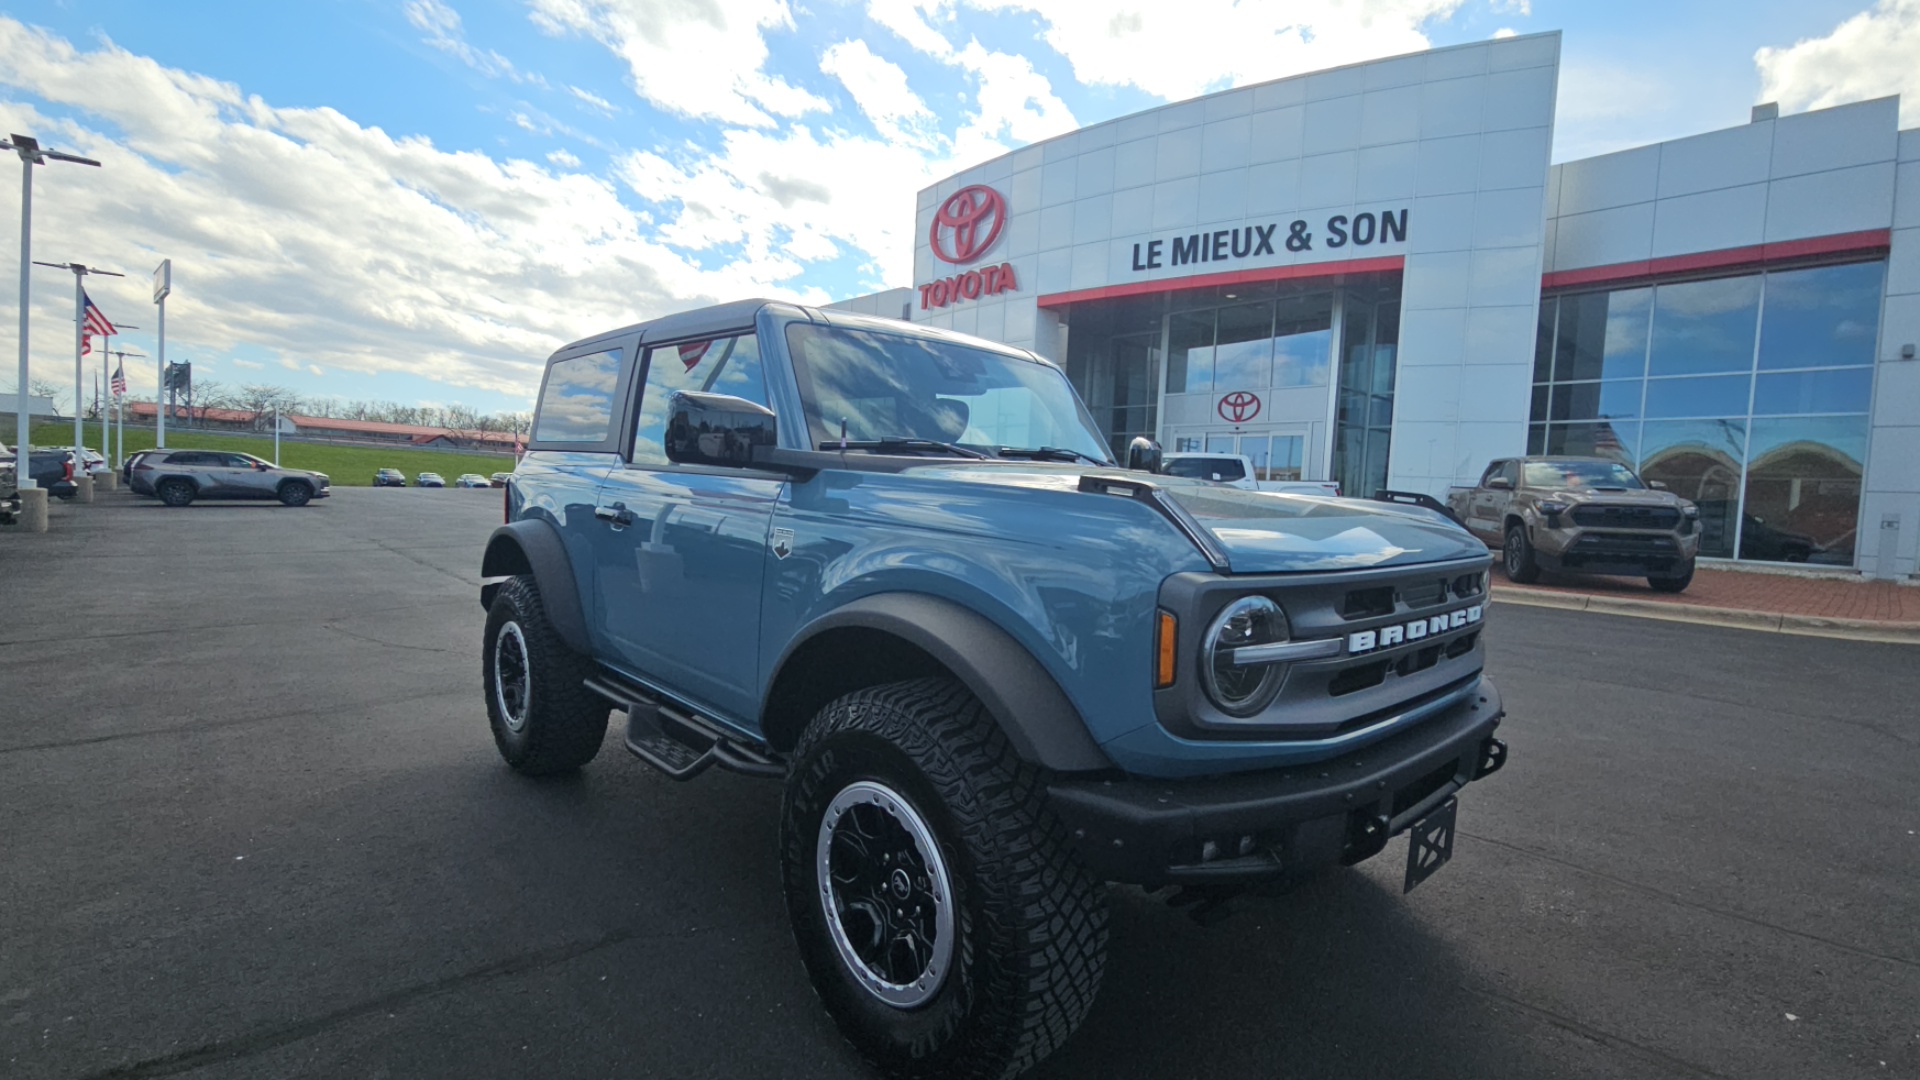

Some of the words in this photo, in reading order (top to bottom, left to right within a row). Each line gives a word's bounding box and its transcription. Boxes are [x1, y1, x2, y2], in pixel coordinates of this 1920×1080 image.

[1132, 239, 1163, 271] LE
[1171, 223, 1277, 267] MIEUX
[1285, 219, 1313, 253] &
[1326, 208, 1408, 249] SON
[918, 262, 1018, 310] TOYOTA
[1349, 605, 1482, 653] BRONCO
